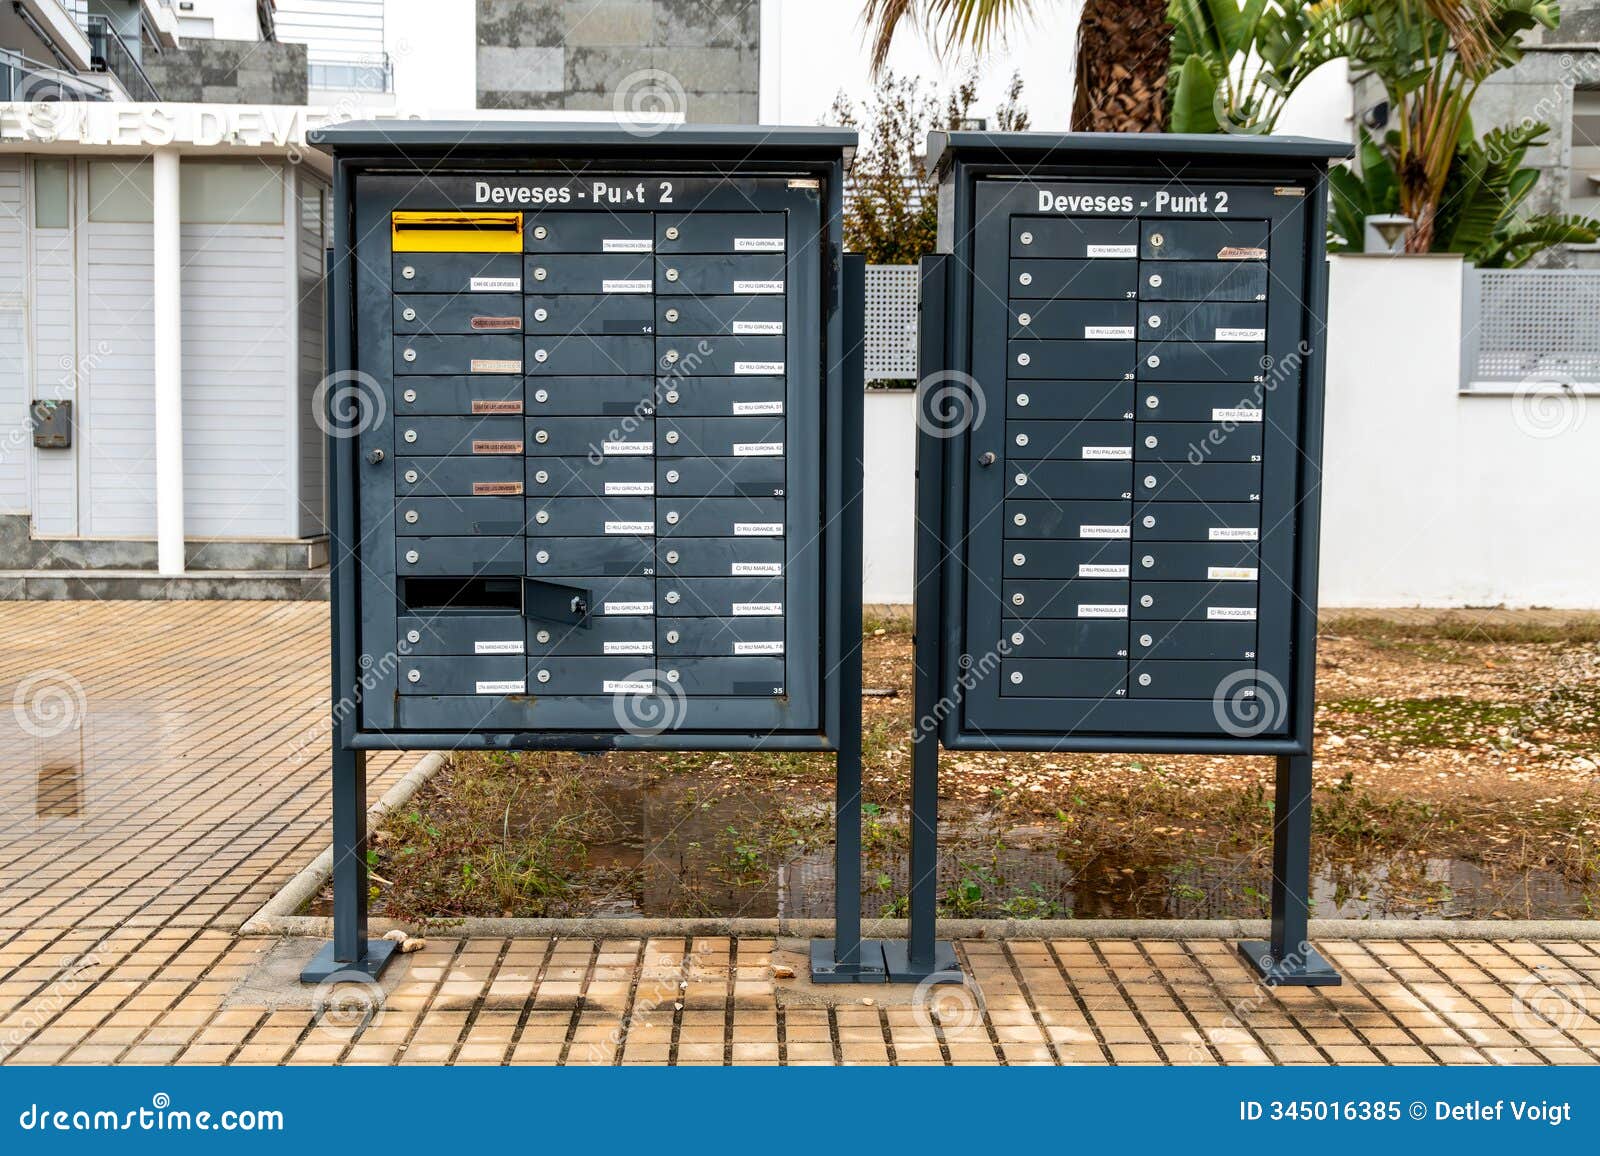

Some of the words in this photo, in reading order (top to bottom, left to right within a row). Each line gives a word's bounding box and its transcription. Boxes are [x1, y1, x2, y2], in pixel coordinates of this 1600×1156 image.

[79, 106, 176, 146] LES
[475, 182, 571, 203] Deveses
[593, 182, 645, 203] Put
[659, 182, 673, 203] 2
[1038, 190, 1134, 212] Deveses
[1155, 191, 1208, 213] Punt
[1214, 192, 1229, 213] 2
